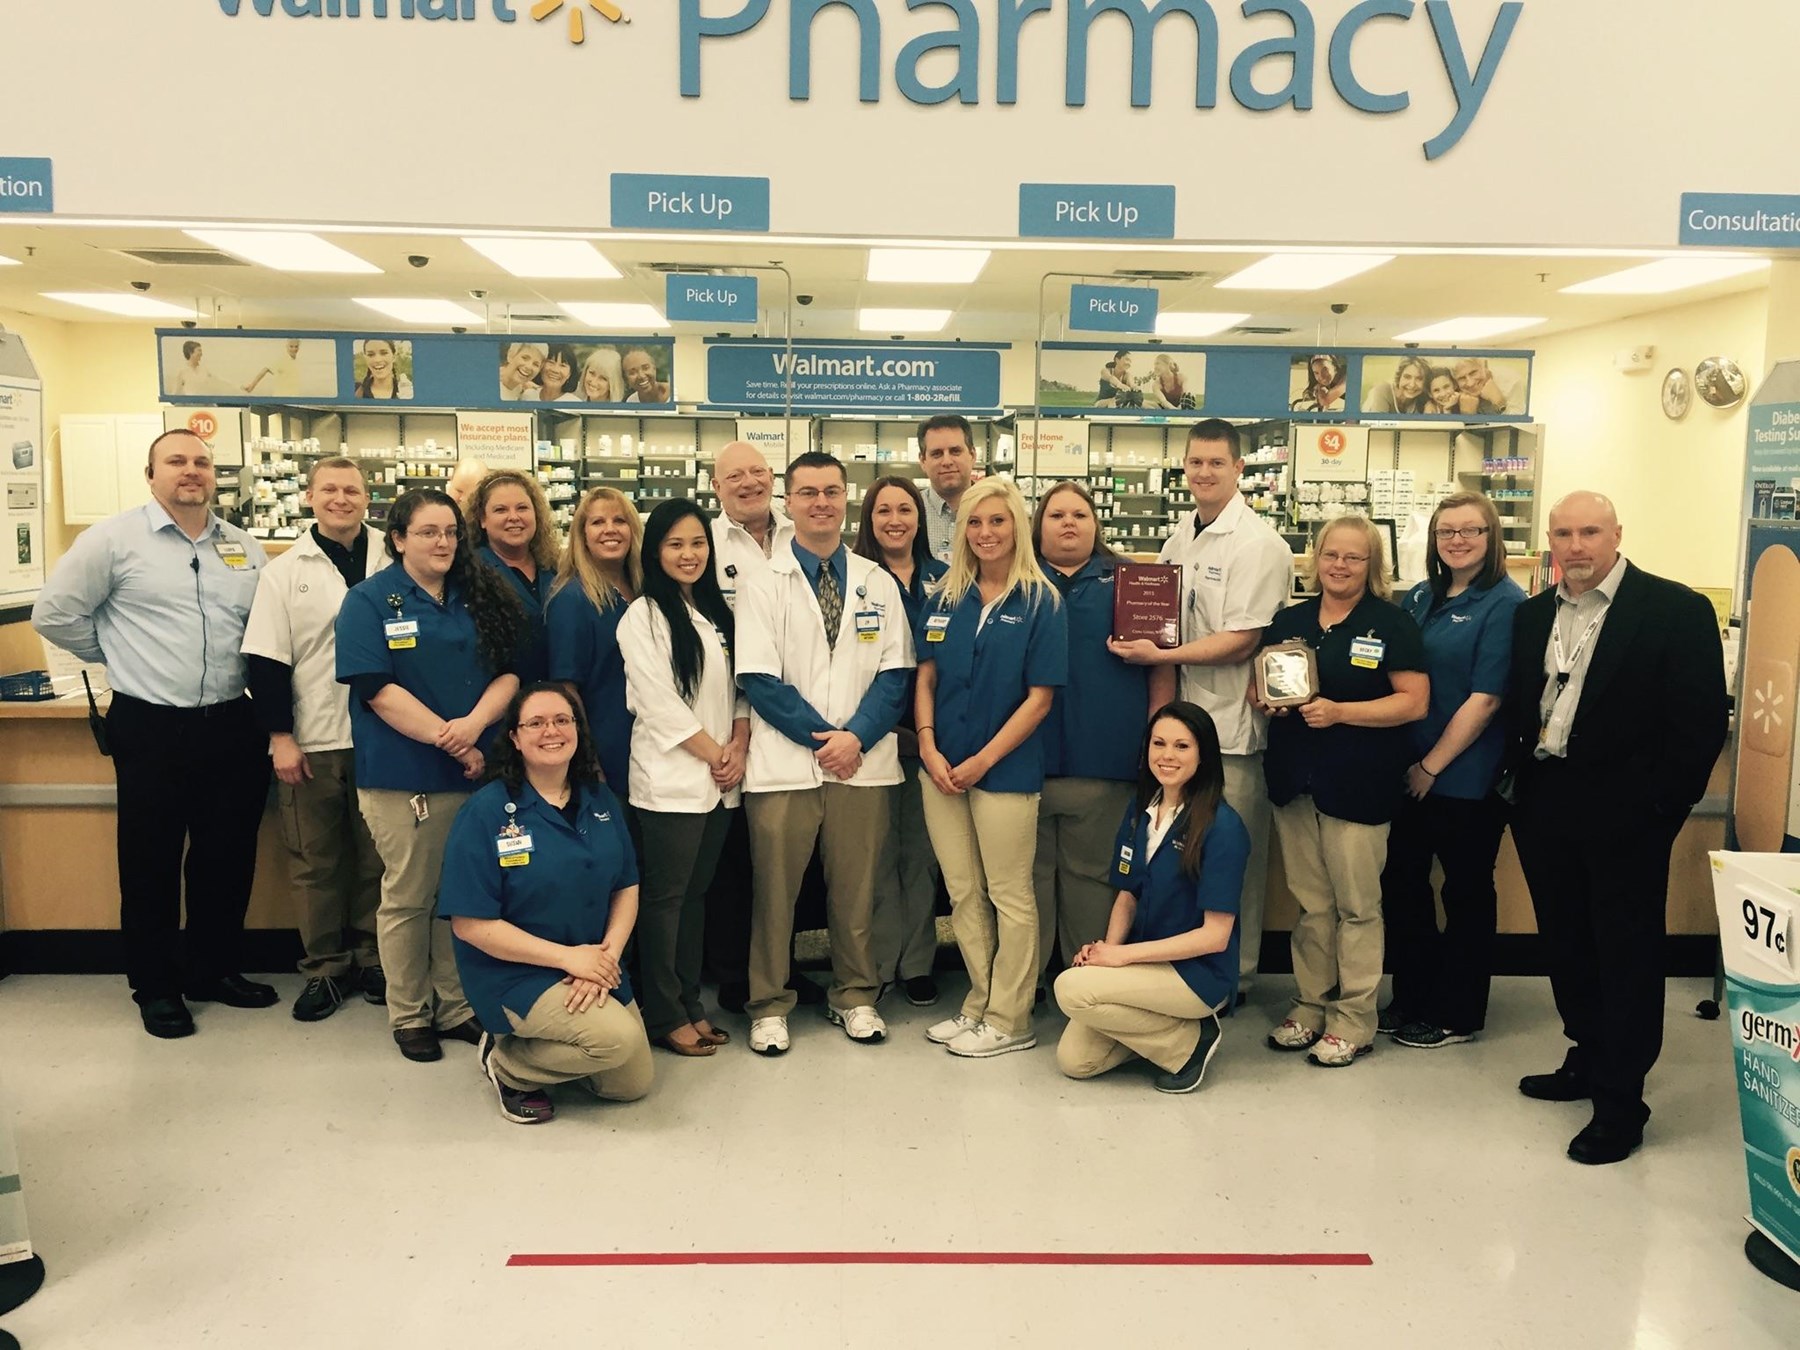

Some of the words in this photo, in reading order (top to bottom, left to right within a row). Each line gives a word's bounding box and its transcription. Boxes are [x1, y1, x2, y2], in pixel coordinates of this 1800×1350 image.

[679, 0, 1524, 161] Pharmacy
[648, 191, 694, 214] Pick
[700, 193, 733, 220] Up
[1055, 201, 1101, 222] Pick
[1107, 202, 1139, 228] Up
[686, 288, 714, 303] Pick
[717, 290, 738, 306] Up
[1089, 298, 1116, 313] Pick
[1119, 300, 1139, 317] Up
[772, 353, 935, 377] Walmart.com
[746, 380, 762, 389] Save
[763, 380, 779, 389] time.
[780, 381, 796, 390] Reill
[797, 382, 813, 390] your
[813, 382, 855, 391] prescriptions
[856, 383, 877, 391] online.
[898, 384, 931, 392] Pharmacy
[746, 391, 756, 399] for
[790, 392, 804, 400] visit
[804, 392, 884, 402] walmart.com/pharmacy
[191, 418, 214, 433] $10
[476, 424, 505, 433] accept
[507, 425, 529, 433] most
[460, 432, 502, 441] insurance
[504, 433, 530, 442] plans.
[746, 432, 785, 441] Walmart
[1021, 433, 1036, 441] Fre
[1040, 433, 1064, 441] Home
[1324, 434, 1341, 450] $4
[1754, 427, 1787, 445] Testing
[465, 444, 495, 453] Including
[1021, 442, 1054, 451] Delvery
[1743, 1048, 1780, 1088] HAND
